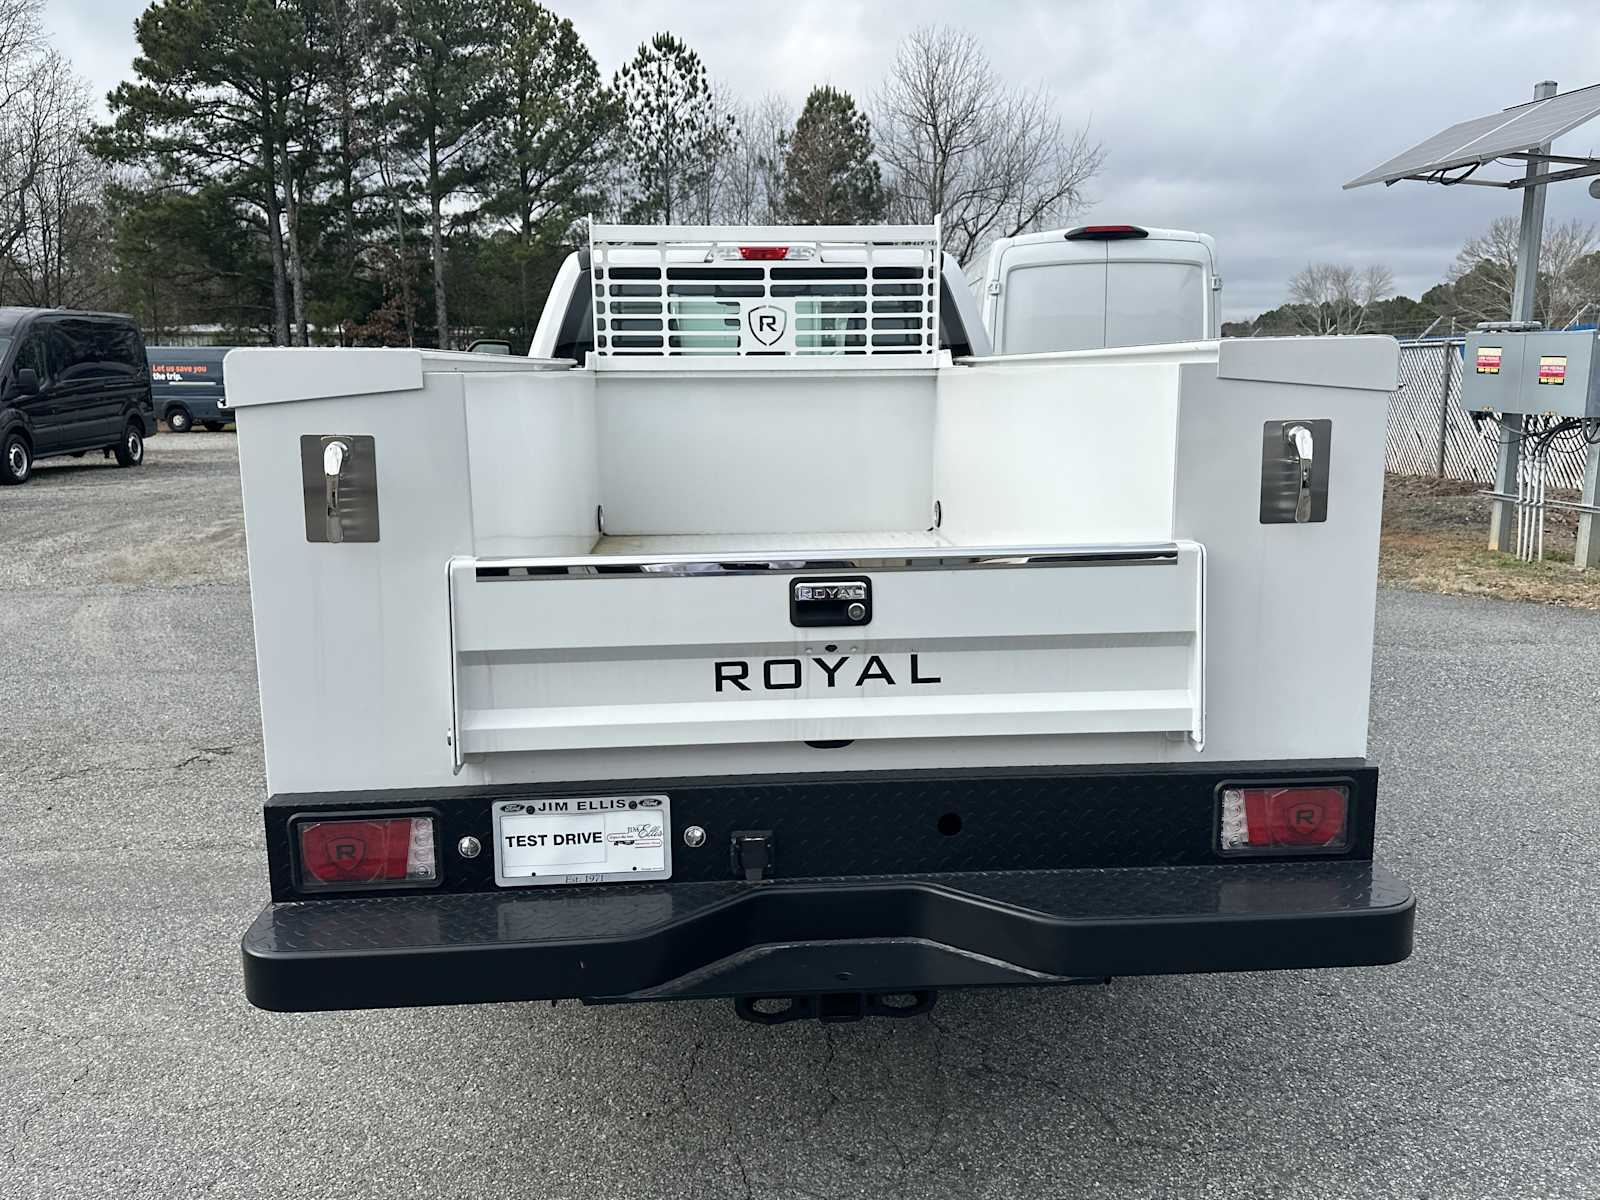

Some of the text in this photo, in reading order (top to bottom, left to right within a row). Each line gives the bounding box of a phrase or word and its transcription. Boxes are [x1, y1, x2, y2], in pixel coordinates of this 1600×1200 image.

[759, 315, 777, 332] R
[152, 364, 165, 372] Let
[193, 365, 207, 374] you
[152, 372, 183, 381] the trip.
[799, 586, 865, 600] ROYAL
[714, 653, 942, 693] ROYAL
[538, 799, 626, 811] JIM ELLIS
[505, 831, 603, 848] TEST DRIVE
